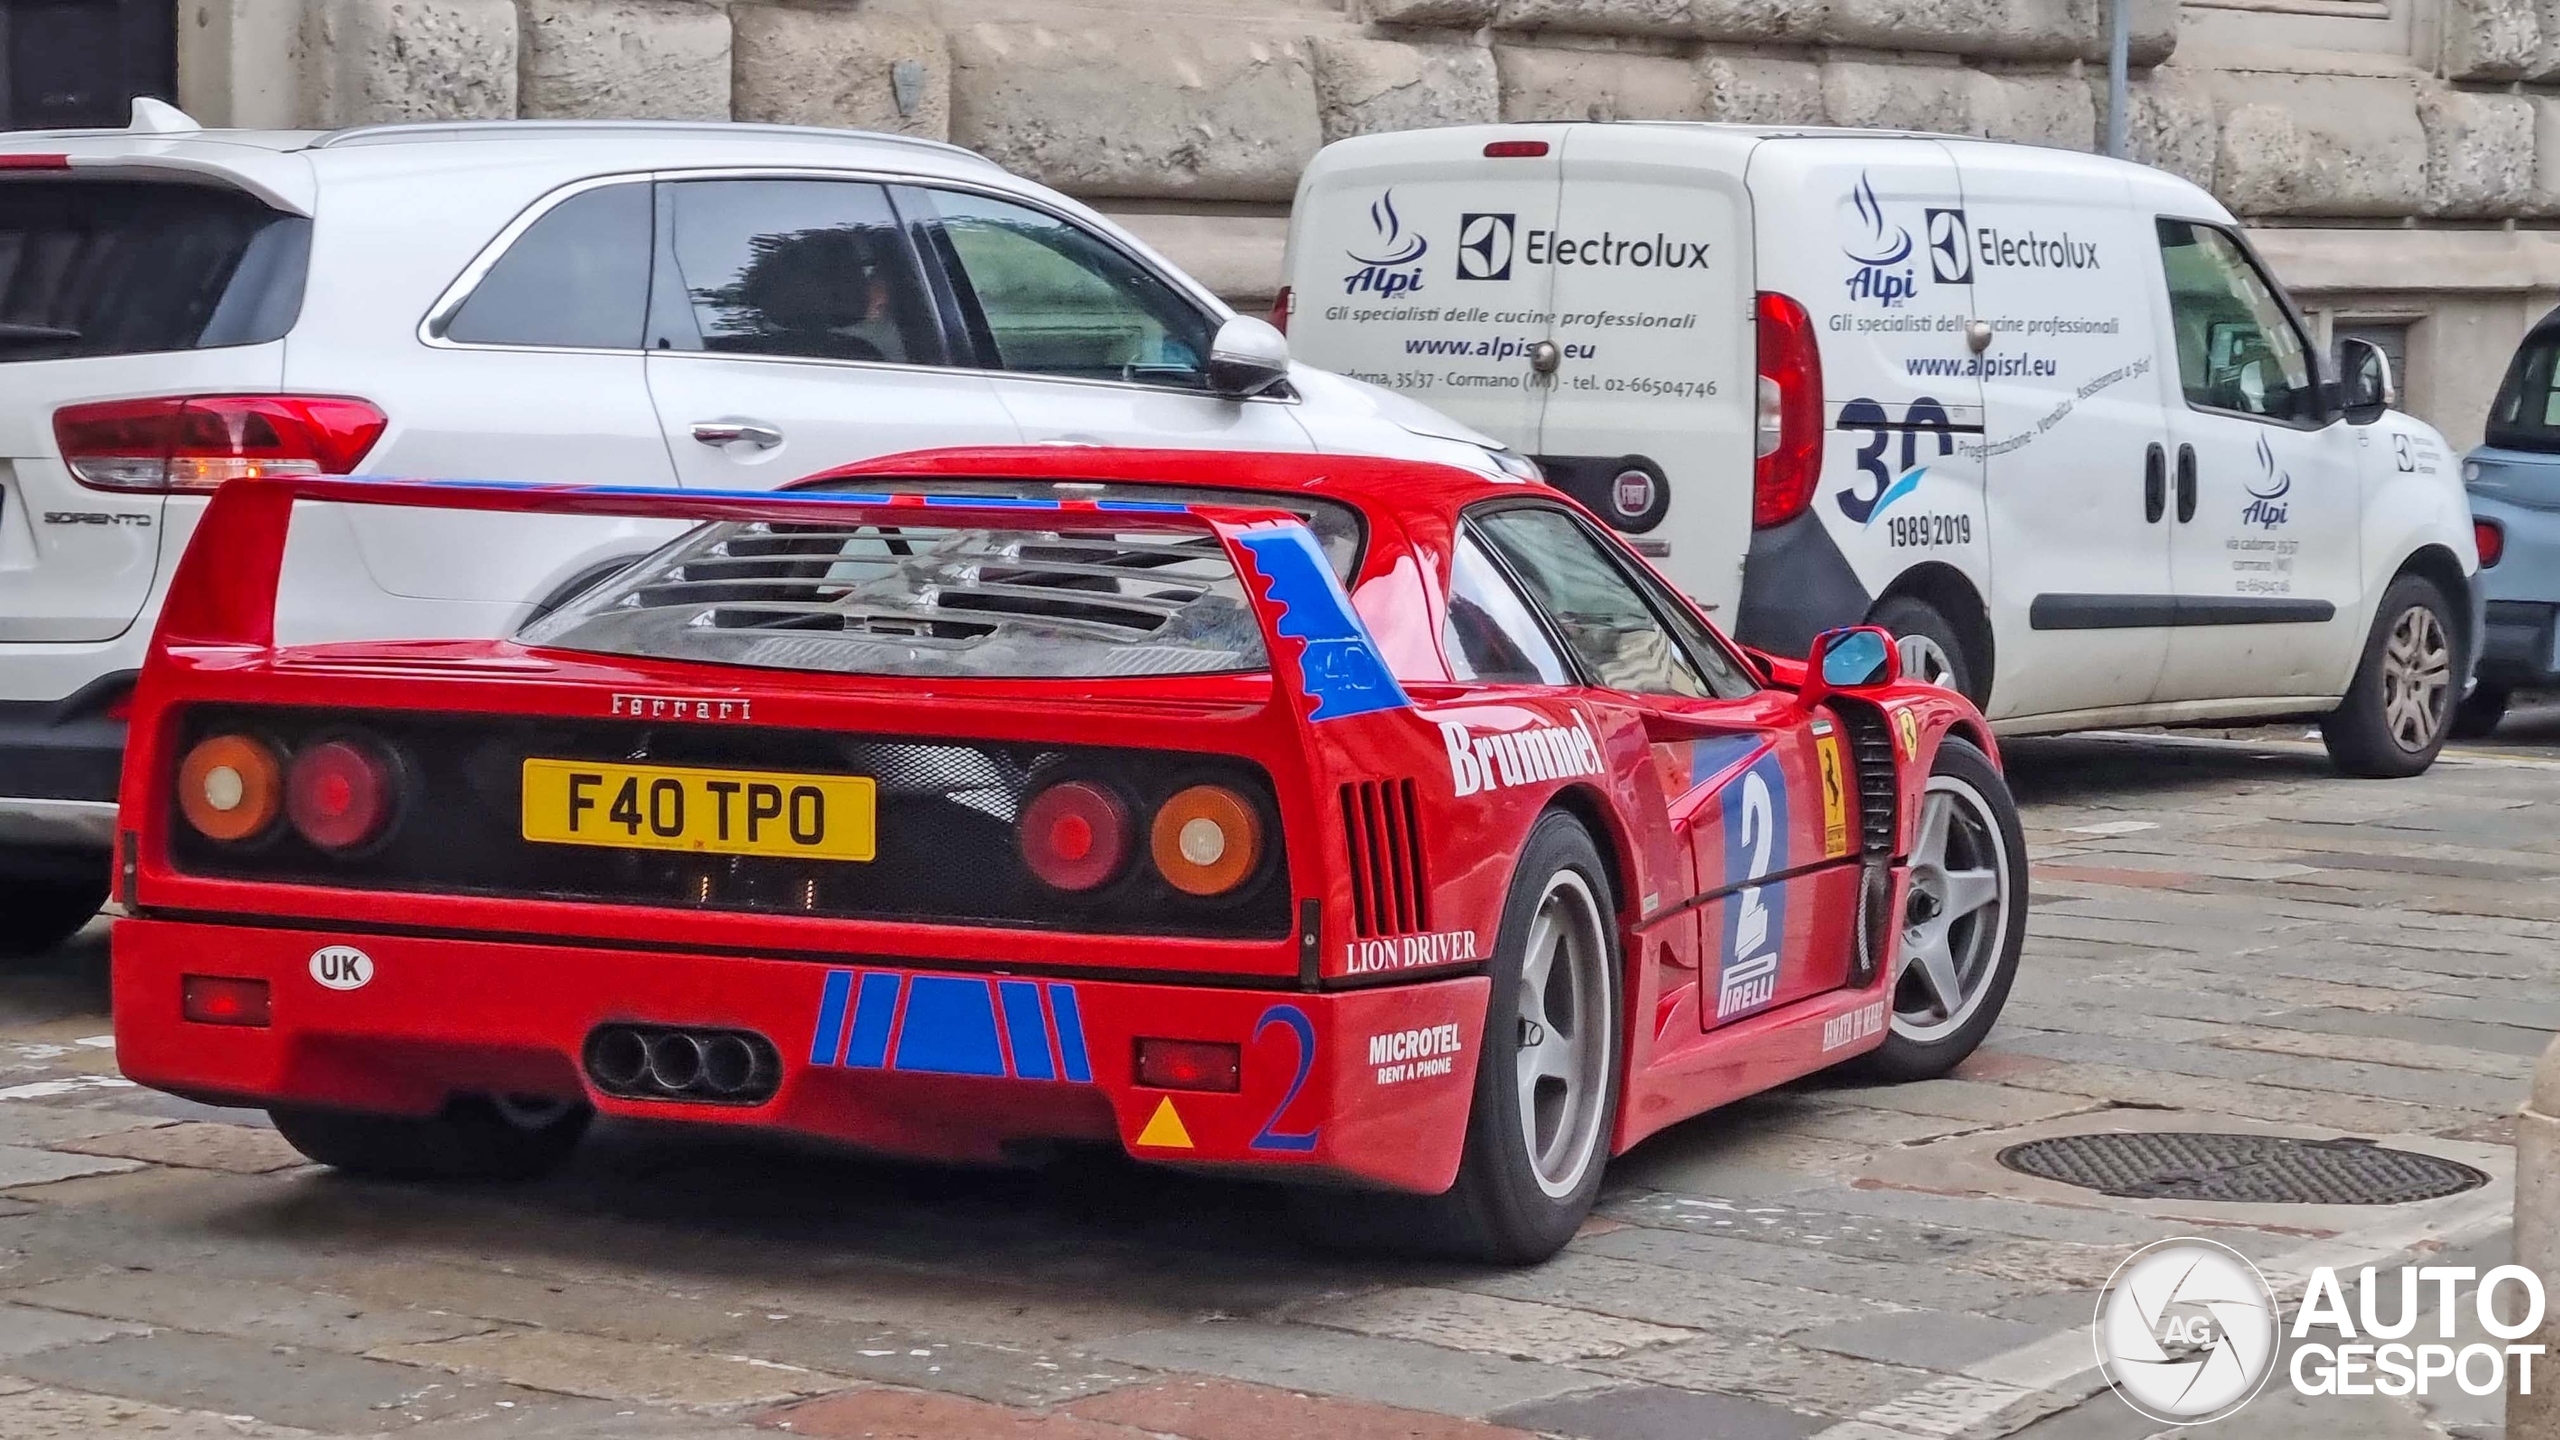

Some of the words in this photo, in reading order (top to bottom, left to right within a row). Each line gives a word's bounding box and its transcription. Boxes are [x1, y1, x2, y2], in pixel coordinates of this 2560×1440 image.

[1527, 230, 1711, 270] Electrolux
[1978, 228, 2101, 270] Electrolux
[1344, 266, 1424, 299] Alpi
[1845, 266, 1918, 308] Alpi
[1325, 305, 1349, 321] Gli
[1352, 306, 1440, 324] specialisti
[1445, 307, 1489, 324] delle
[1494, 308, 1555, 325] cucine
[1560, 311, 1697, 330] professionali
[1829, 314, 1853, 332] Gli
[1857, 314, 1932, 336] specialisti
[2027, 317, 2120, 337] professionali
[1396, 370, 1435, 389] 35/37
[1446, 372, 1520, 389] Cormano
[1573, 374, 1600, 391] tel.
[1605, 378, 1718, 397] 02-66504746
[1906, 353, 2057, 382] www.alpisrl.eu
[44, 511, 151, 527] SORENTO
[2242, 500, 2289, 530] Alpi
[612, 693, 752, 720] Ferrari
[1437, 708, 1605, 798] Brummel
[568, 773, 685, 838] F40
[706, 780, 825, 846] TPO
[1734, 770, 1774, 961] 2
[319, 954, 362, 982] UK
[1346, 940, 1399, 975] LION
[1403, 929, 1477, 969] DRIVER
[1716, 952, 1778, 1019] PIRELLI
[1369, 1023, 1462, 1066] MICROTEL
[1249, 1003, 1320, 1153] 2
[1377, 1064, 1407, 1085] RENT
[1407, 1062, 1415, 1080] A
[1417, 1056, 1452, 1080] PHONE
